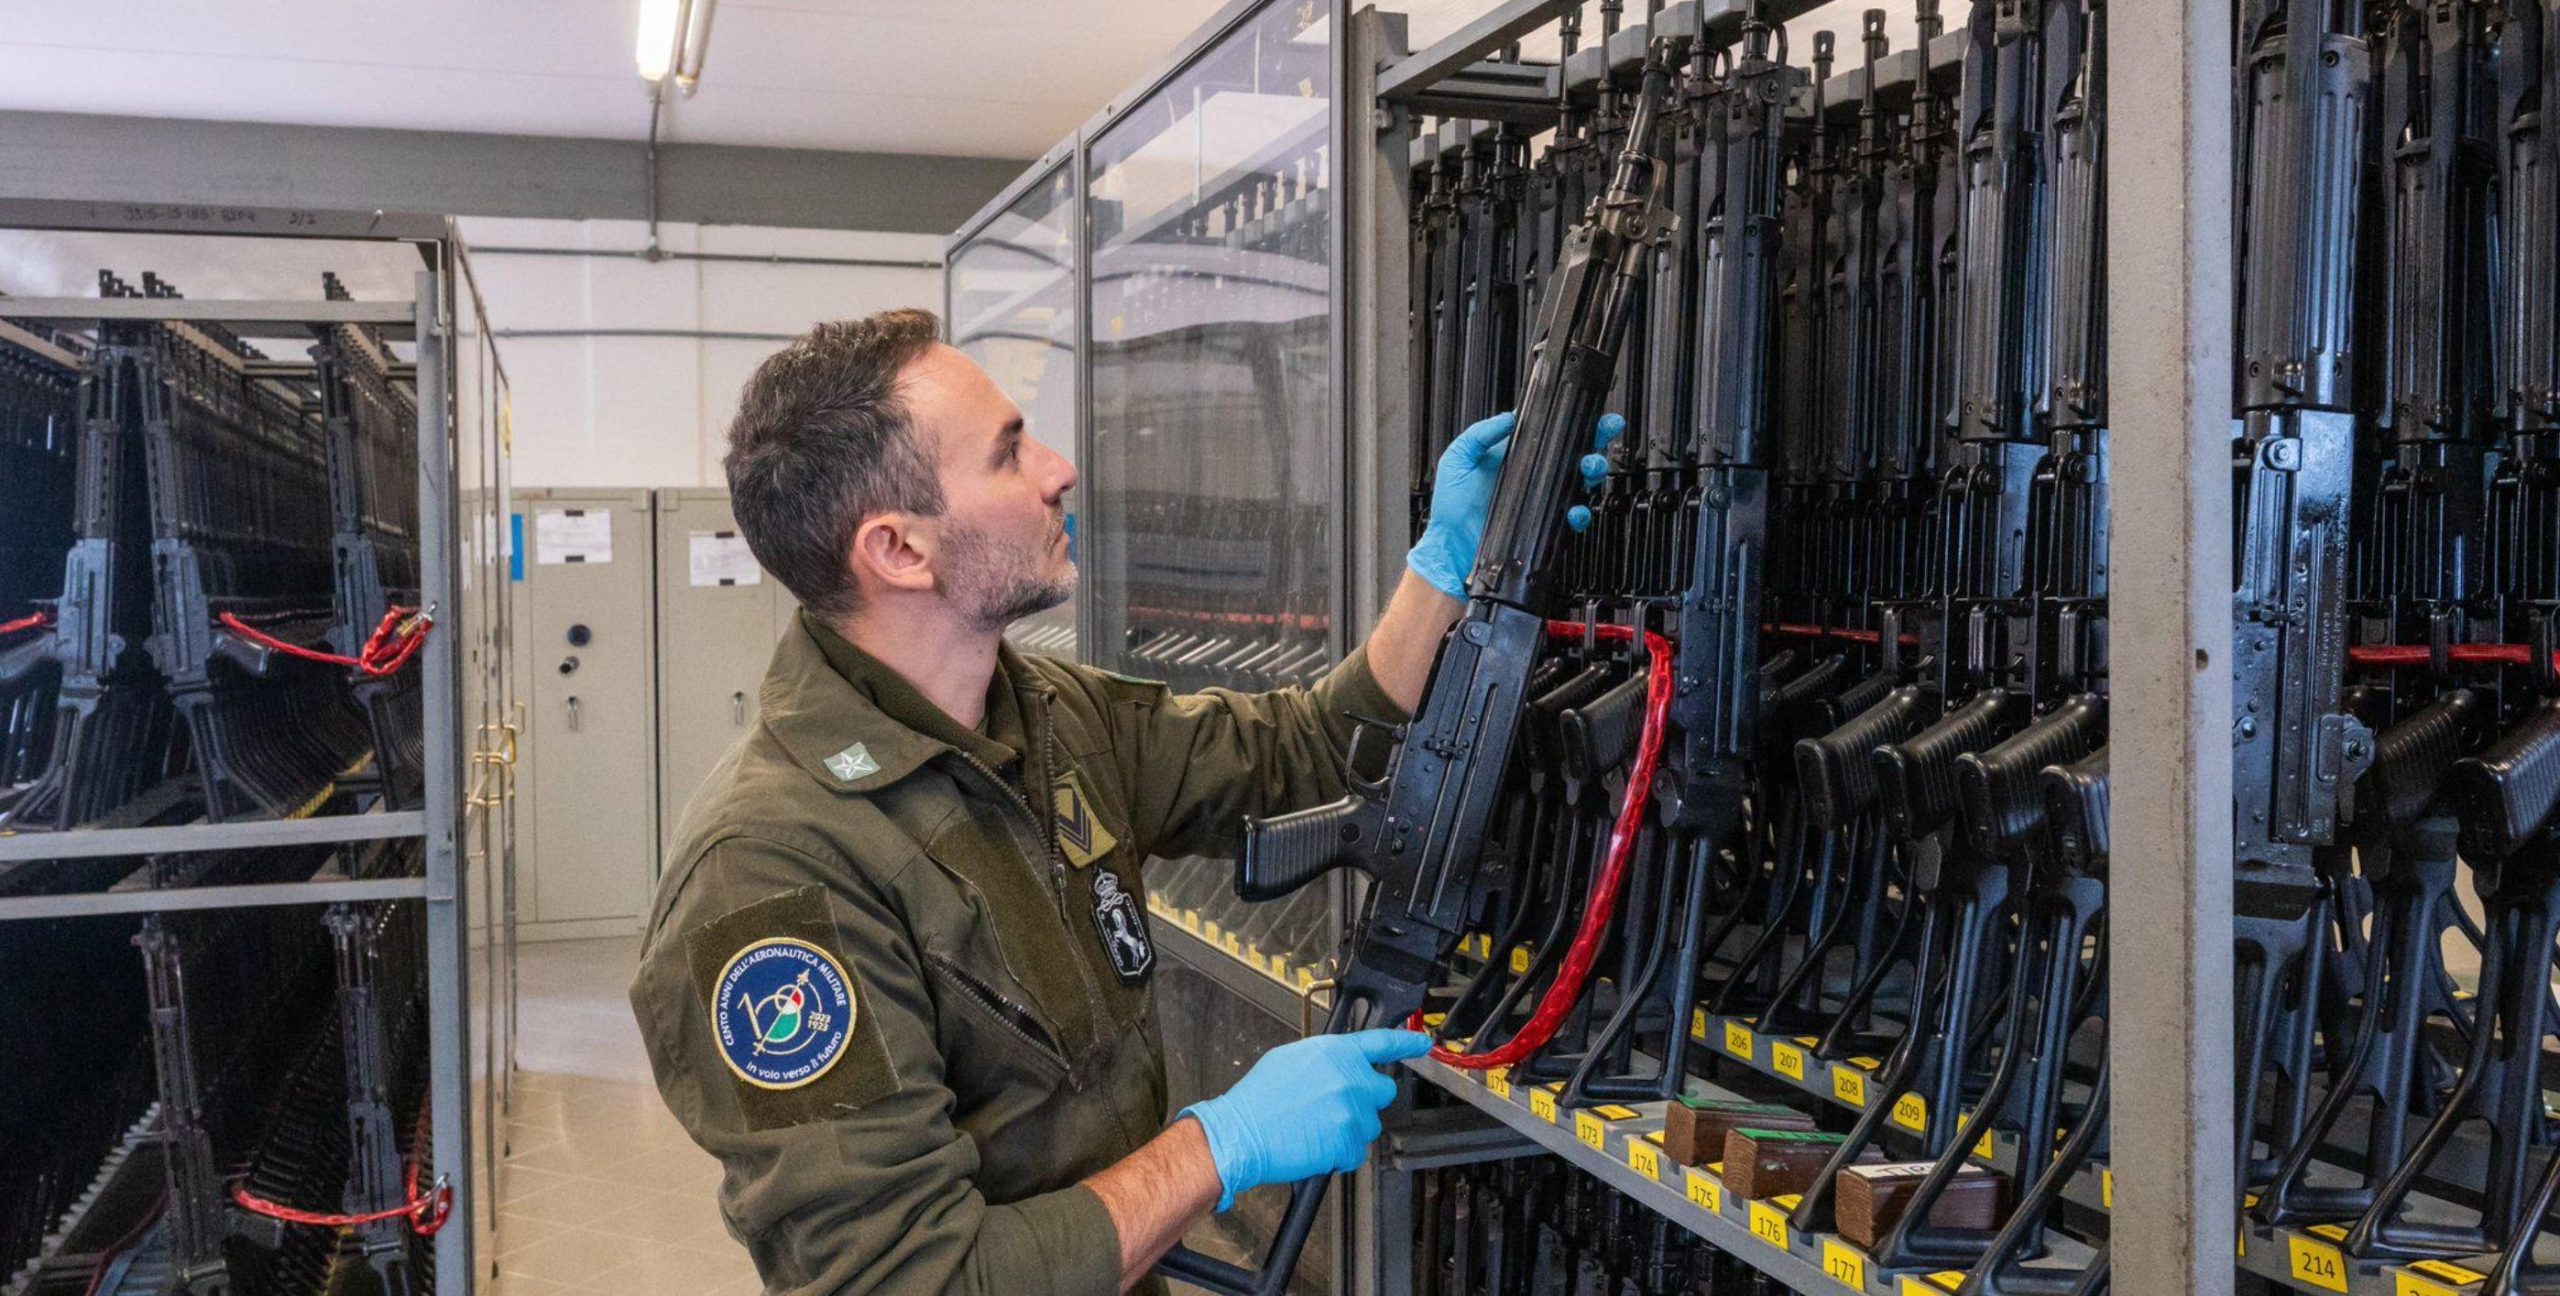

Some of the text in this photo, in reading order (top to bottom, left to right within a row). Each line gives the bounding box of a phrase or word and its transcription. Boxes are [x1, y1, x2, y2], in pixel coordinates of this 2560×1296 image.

[720, 947, 847, 1046] CENTO ANNI DELL'AERONAUTICA MILITARE
[1731, 1032, 1748, 1050] 206
[783, 1065, 810, 1080] verso
[811, 1058, 818, 1069] il
[818, 1031, 842, 1062] futuro
[1780, 1052, 1798, 1069] 207
[1840, 1076, 1858, 1096] 208
[1536, 1100, 1550, 1120] 172
[1900, 1101, 1920, 1121] 209
[1582, 1124, 1598, 1144] 173
[1634, 1153, 1653, 1175] 174
[1693, 1185, 1713, 1209] 175
[1759, 1217, 1781, 1242] 176
[1832, 1258, 1855, 1283] 177
[2302, 1252, 2335, 1278] 214
